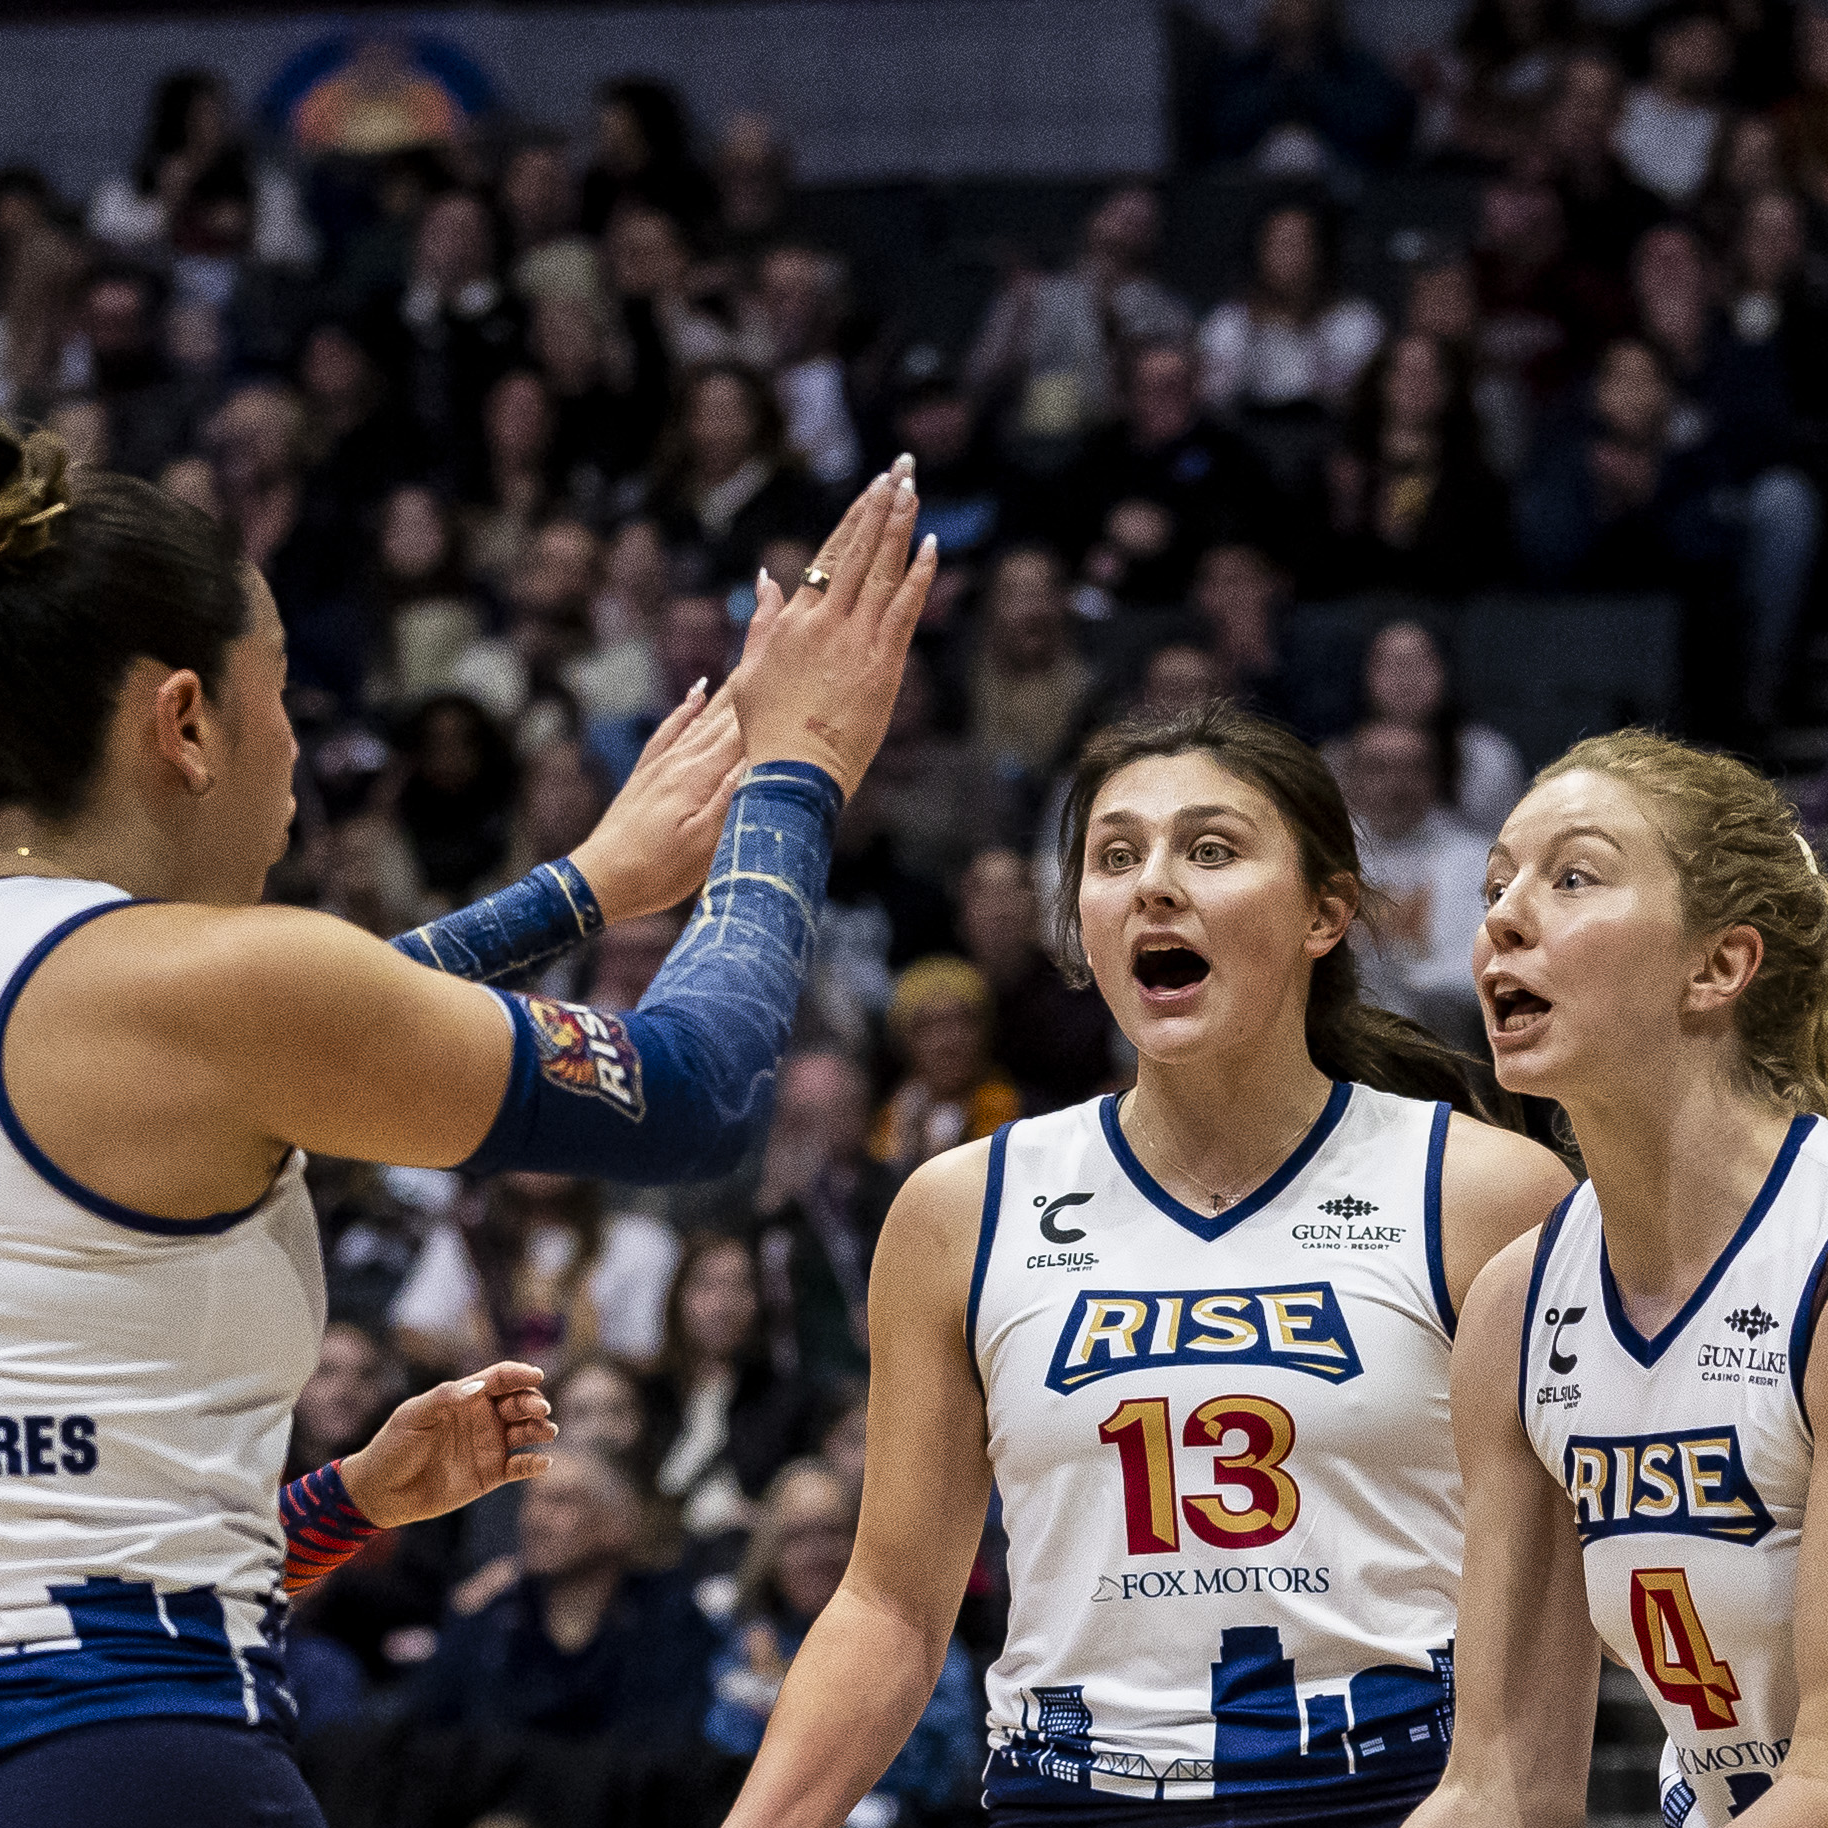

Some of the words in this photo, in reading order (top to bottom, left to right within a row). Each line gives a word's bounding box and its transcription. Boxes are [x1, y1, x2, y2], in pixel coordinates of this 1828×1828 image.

[1292, 1224, 1342, 1240] GUN
[1346, 1225, 1402, 1243] LAKE
[1026, 1252, 1095, 1269] CELSIUS
[1065, 1291, 1349, 1369] RISE
[1698, 1343, 1744, 1368] GUN
[1701, 1371, 1741, 1383] CASINO
[1098, 1393, 1301, 1556] 13
[1570, 1438, 1757, 1524] RISE
[1121, 1570, 1188, 1600] FOX
[1194, 1567, 1330, 1595] MOTORS
[1630, 1567, 1742, 1731] 4
